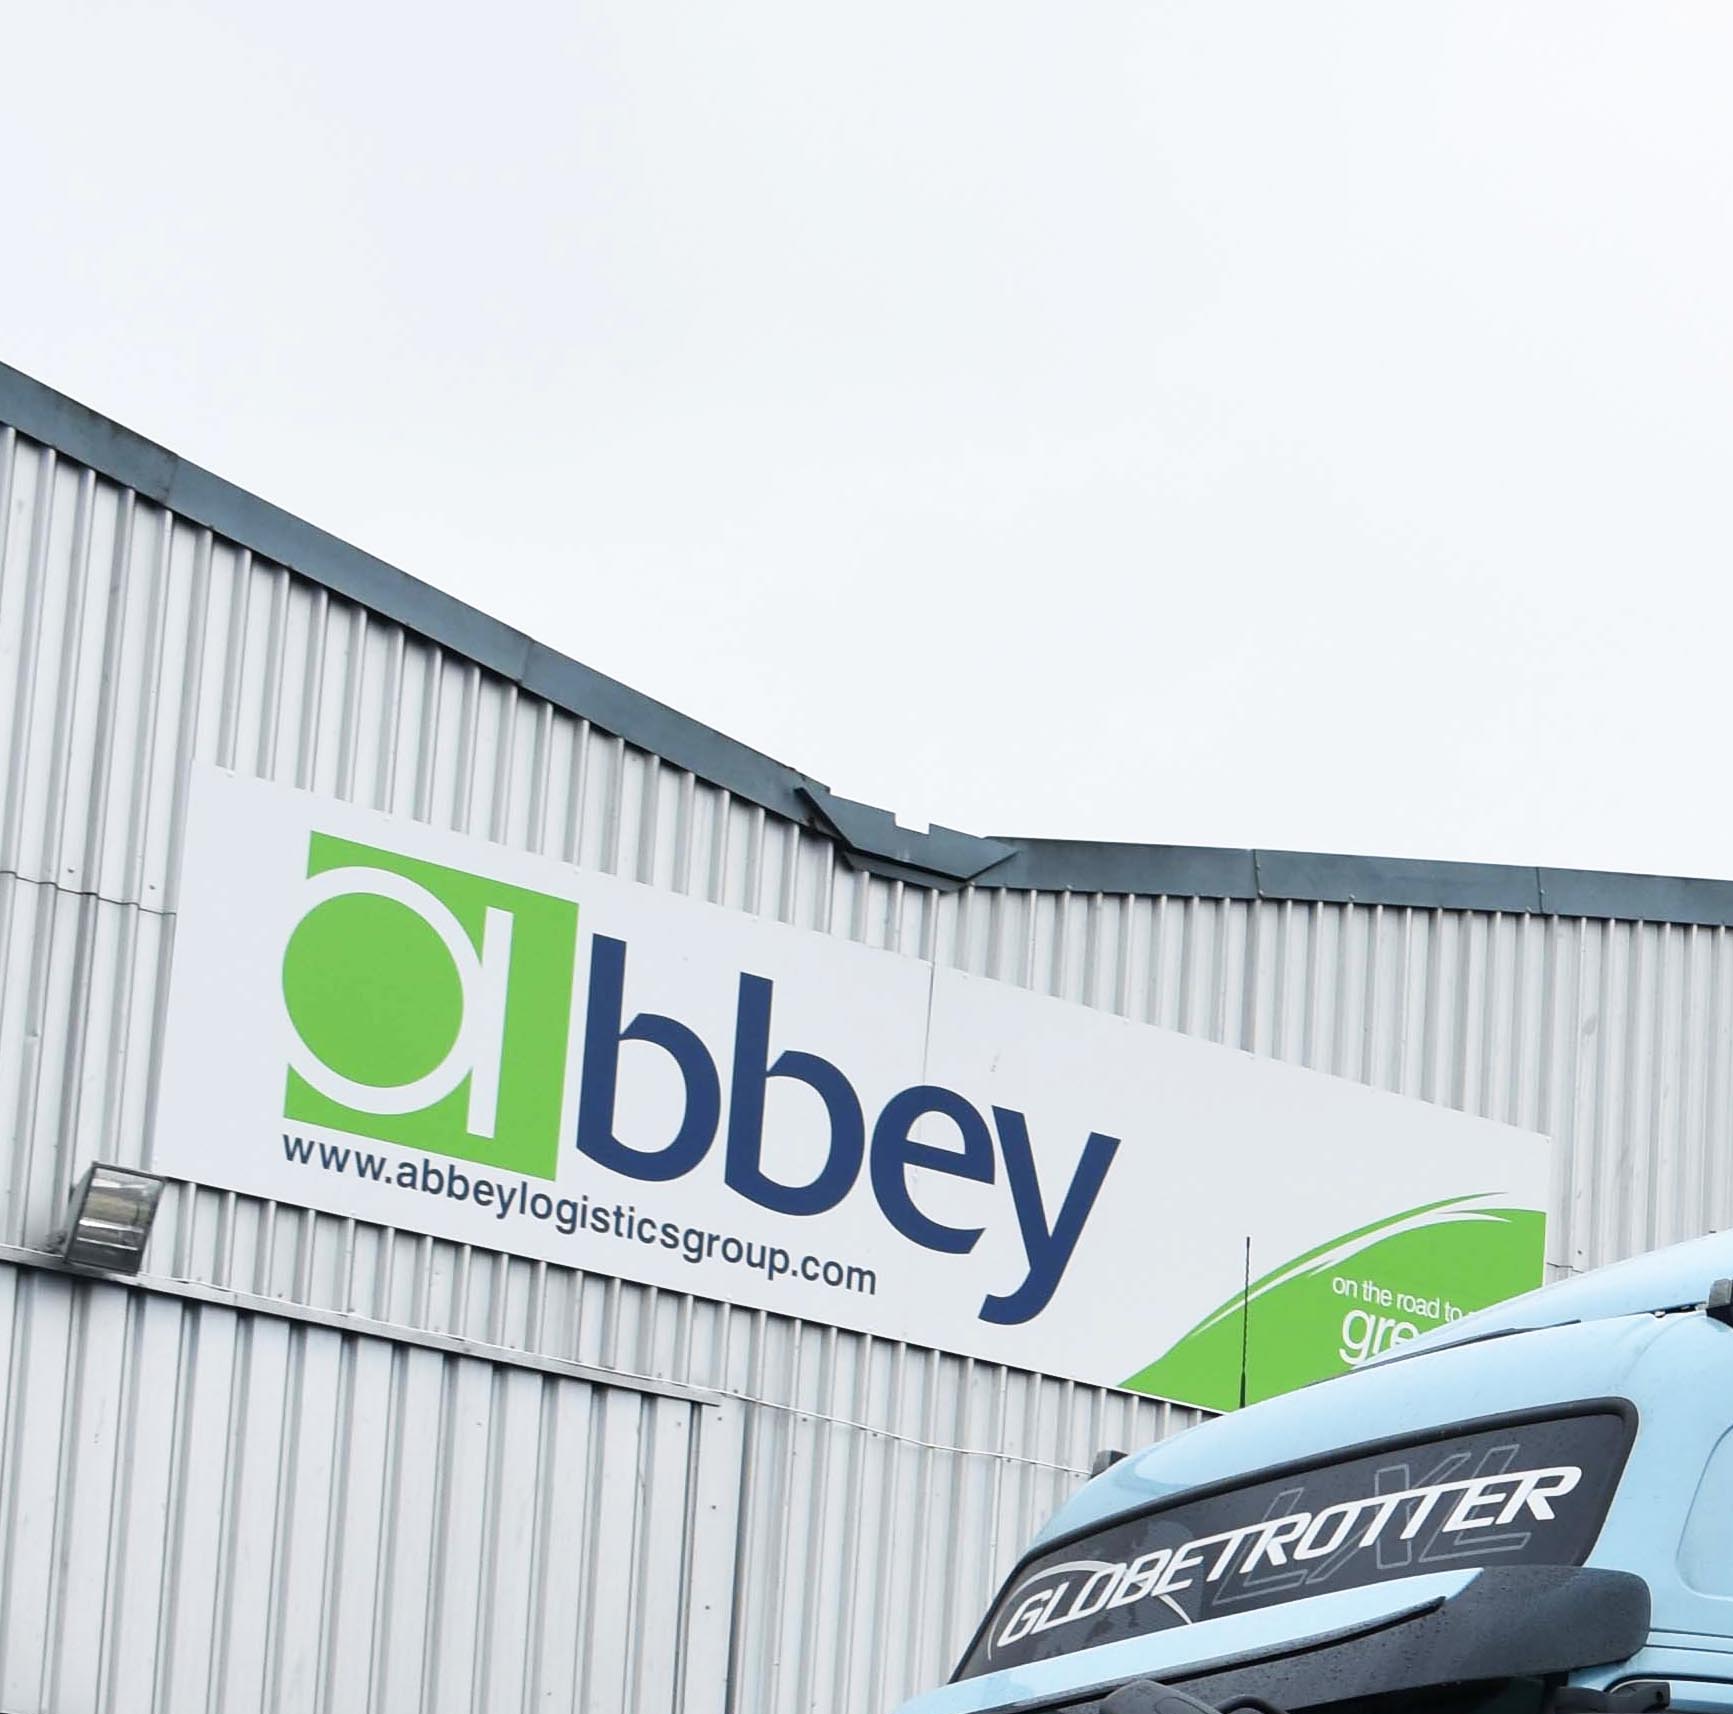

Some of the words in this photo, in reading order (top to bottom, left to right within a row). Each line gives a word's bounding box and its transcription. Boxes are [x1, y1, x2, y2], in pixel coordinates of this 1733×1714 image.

[282, 866, 1121, 1325] abbey
[283, 1133, 876, 1295] www.abbeylogisticsgroup.com
[1332, 1277, 1358, 1298] on
[1361, 1280, 1392, 1306] the
[1396, 1294, 1440, 1319] road
[1445, 1304, 1463, 1322] to
[998, 1466, 1582, 1647] GLOBETROTTER
